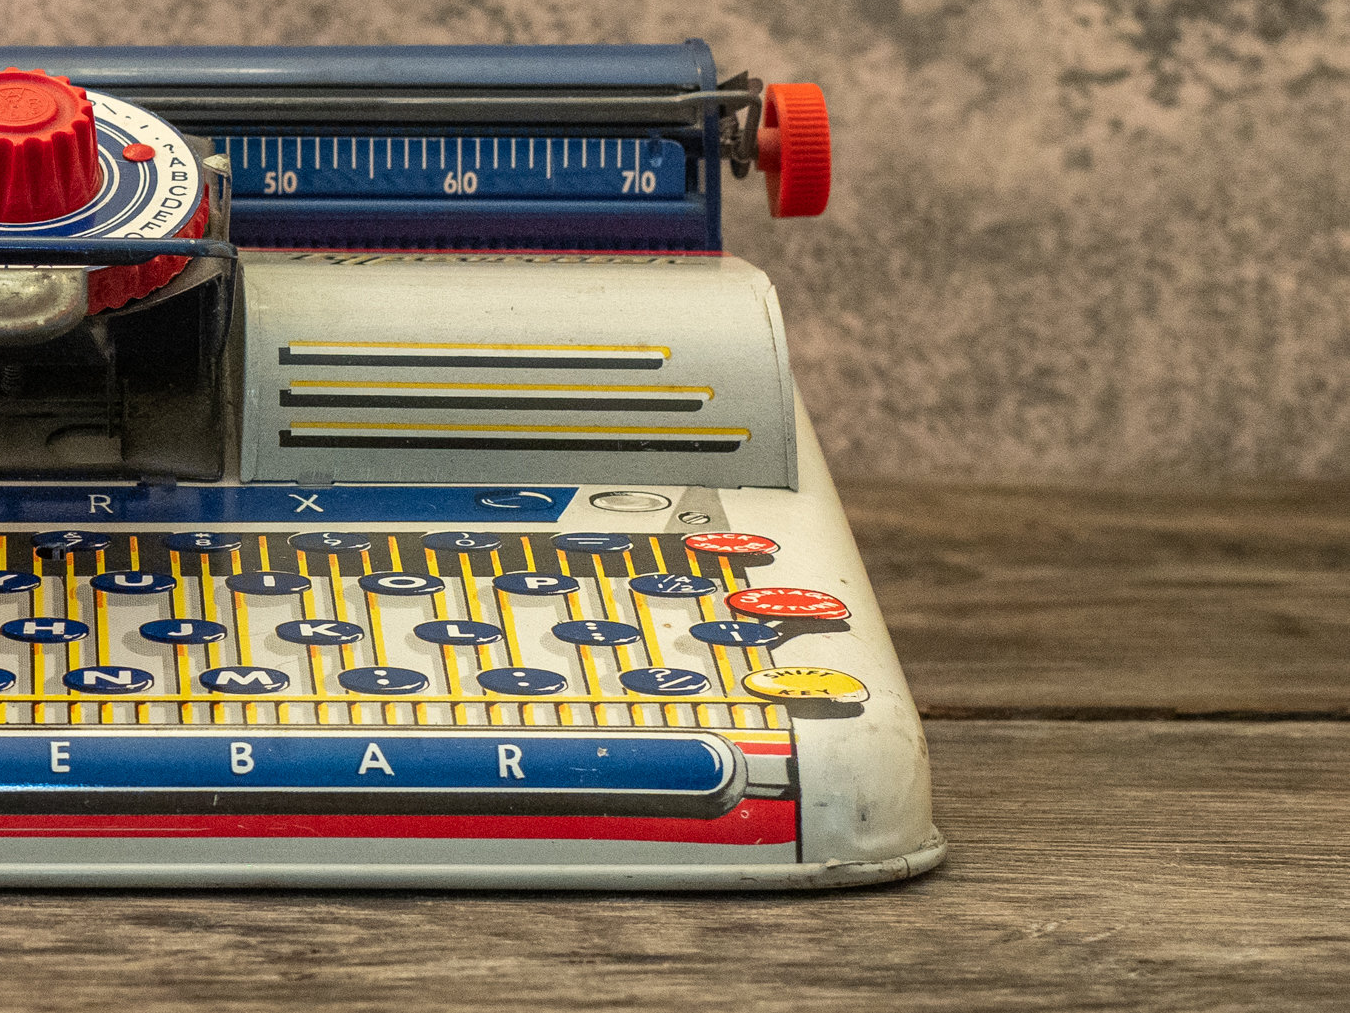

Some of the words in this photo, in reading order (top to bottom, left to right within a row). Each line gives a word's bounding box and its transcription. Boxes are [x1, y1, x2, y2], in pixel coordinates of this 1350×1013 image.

[169, 157, 187, 168] A
[171, 171, 188, 182] B
[264, 172, 297, 194] 50
[443, 172, 478, 195] 60
[622, 172, 656, 195] 70
[169, 186, 188, 197] C
[160, 197, 183, 209] D
[152, 210, 173, 223] E
[139, 221, 162, 231] F
[114, 574, 154, 587] U
[263, 575, 276, 588] I
[377, 575, 427, 589] O
[524, 576, 552, 589] P
[22, 621, 65, 636] H
[167, 622, 194, 636] J
[299, 622, 342, 637] K
[446, 624, 475, 639] L
[82, 670, 133, 685] N
[215, 670, 274, 686] M
[764, 669, 834, 679] SHIFT
[777, 688, 830, 696] KEY
[230, 741, 526, 779] BAR
